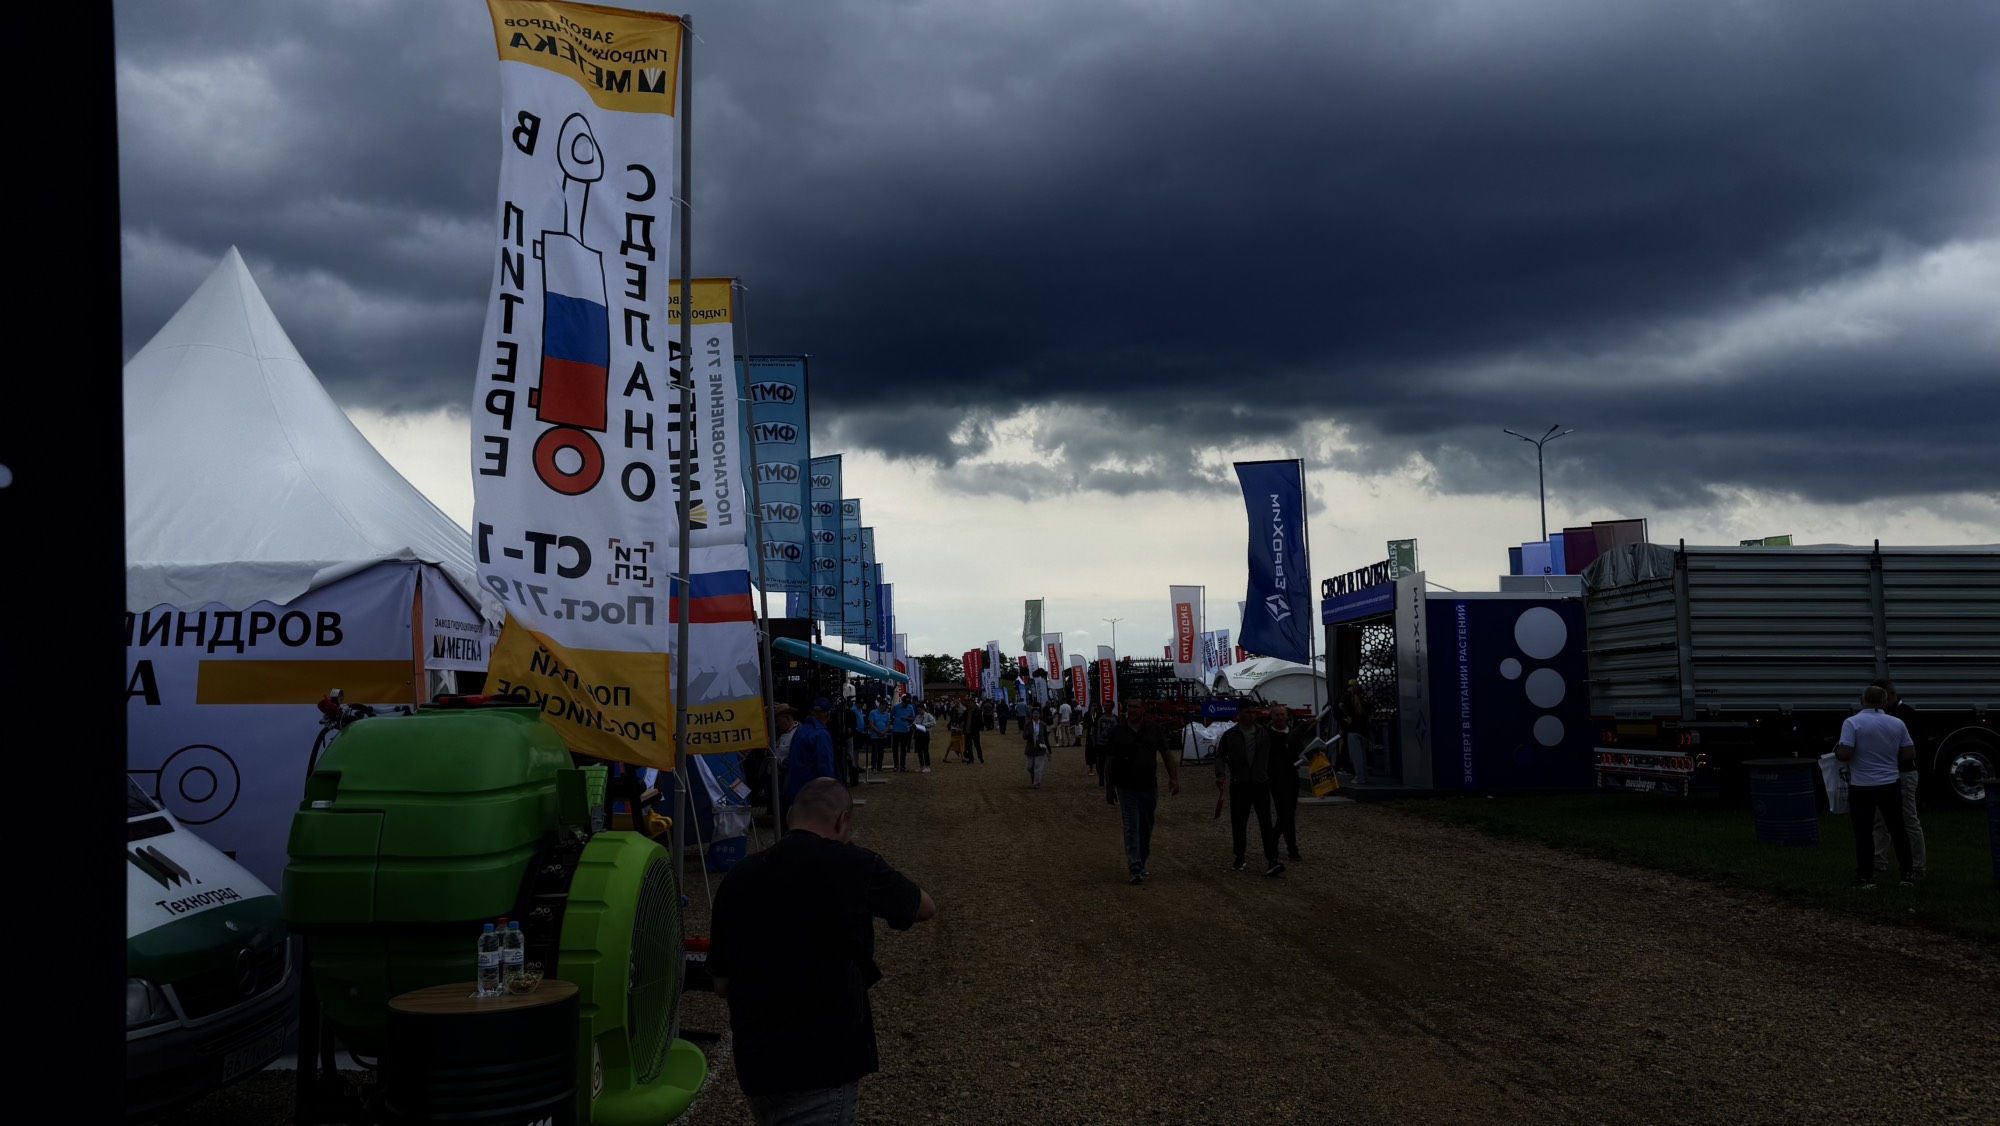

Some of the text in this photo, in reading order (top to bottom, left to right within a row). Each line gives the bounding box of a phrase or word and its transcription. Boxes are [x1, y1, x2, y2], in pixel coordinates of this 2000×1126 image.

[446, 636, 482, 661] МЕТЕКА
[1456, 605, 1473, 783] ЭКСПЕРТ В ПИТАНИИ РАСТЕНИЙ
[156, 886, 242, 916] Техноград
